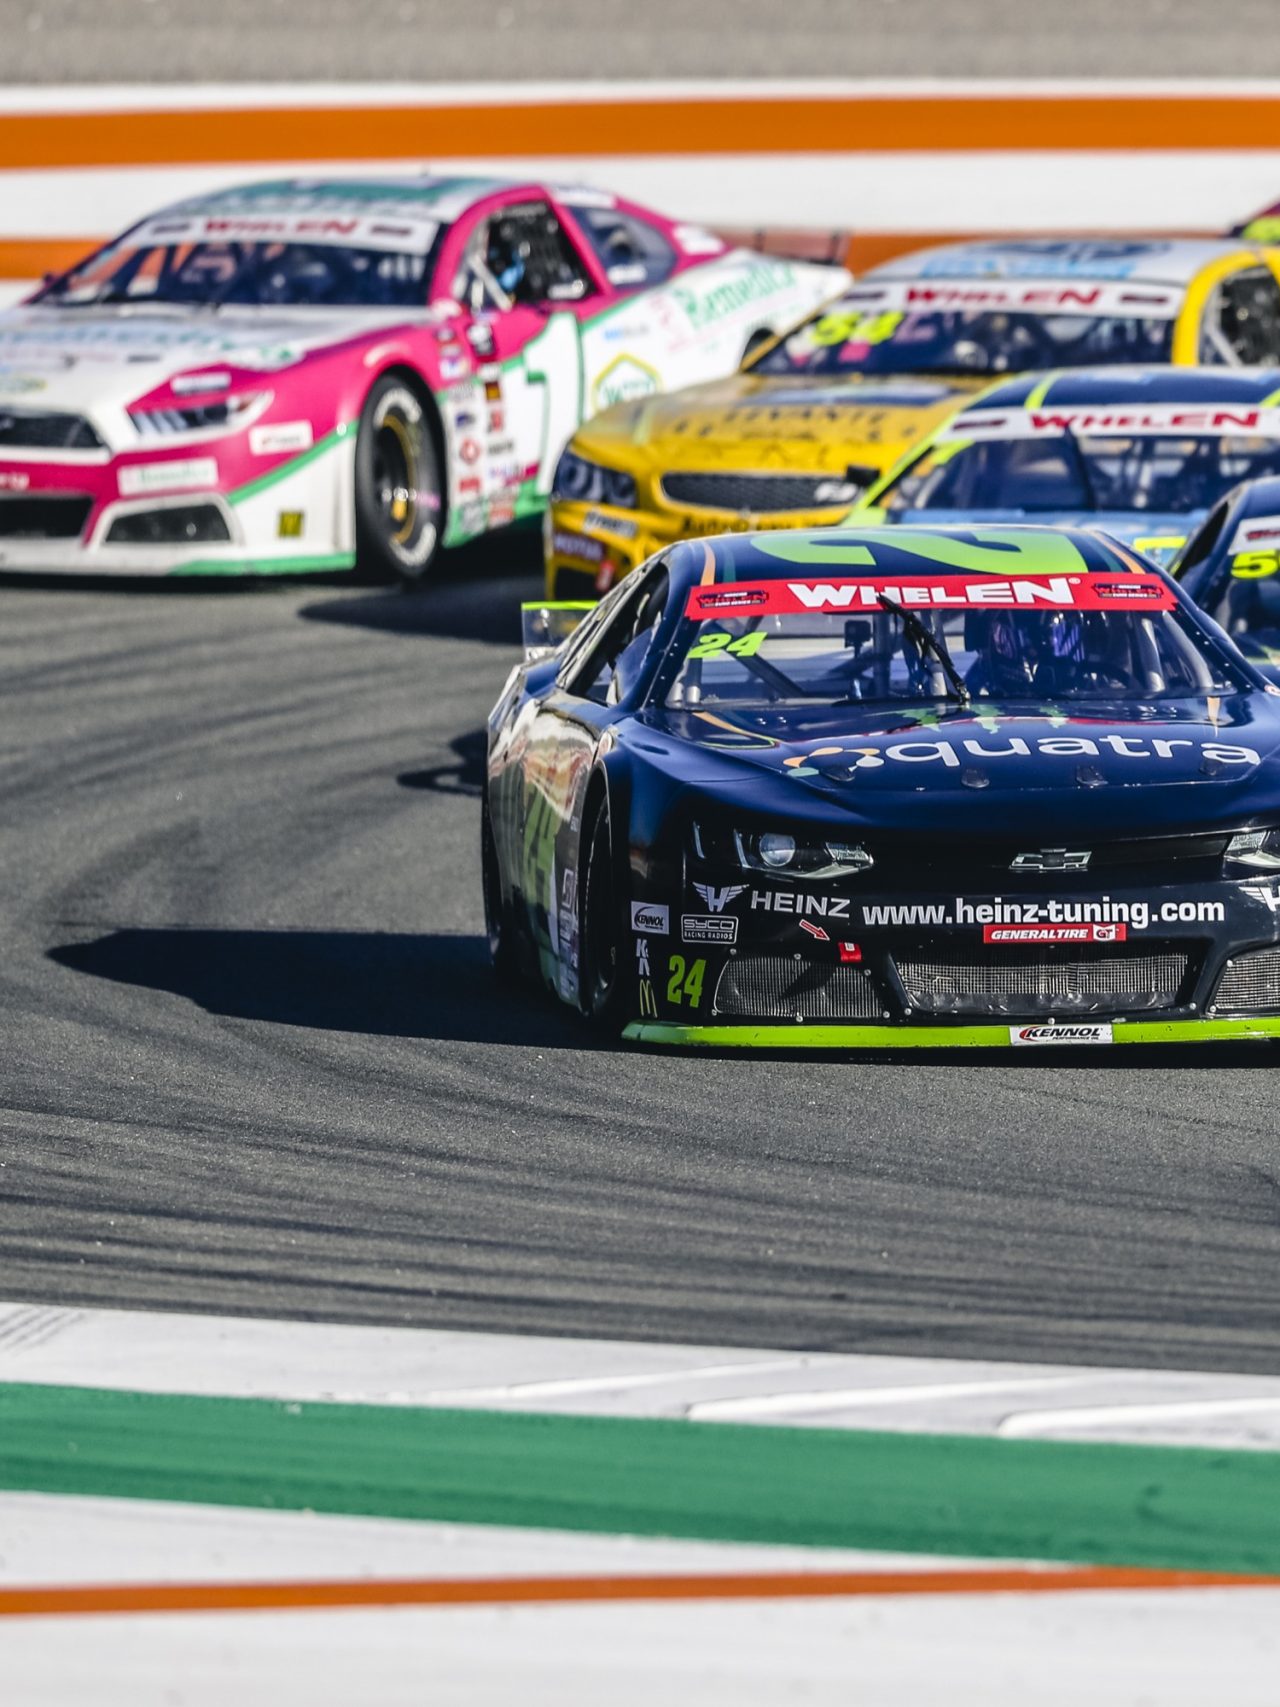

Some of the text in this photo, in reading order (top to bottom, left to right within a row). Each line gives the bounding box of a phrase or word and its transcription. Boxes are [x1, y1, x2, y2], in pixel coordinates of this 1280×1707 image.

[1029, 411, 1260, 431] WHELEN
[786, 576, 1075, 608] WHELEN
[686, 631, 768, 659] 24
[750, 890, 851, 918] HEINZ
[861, 895, 1226, 930] www.heinz-tuning.com
[683, 931, 734, 941] RACING RADIOS
[666, 954, 707, 1009] 24
[1025, 1027, 1102, 1038] KENNOL
